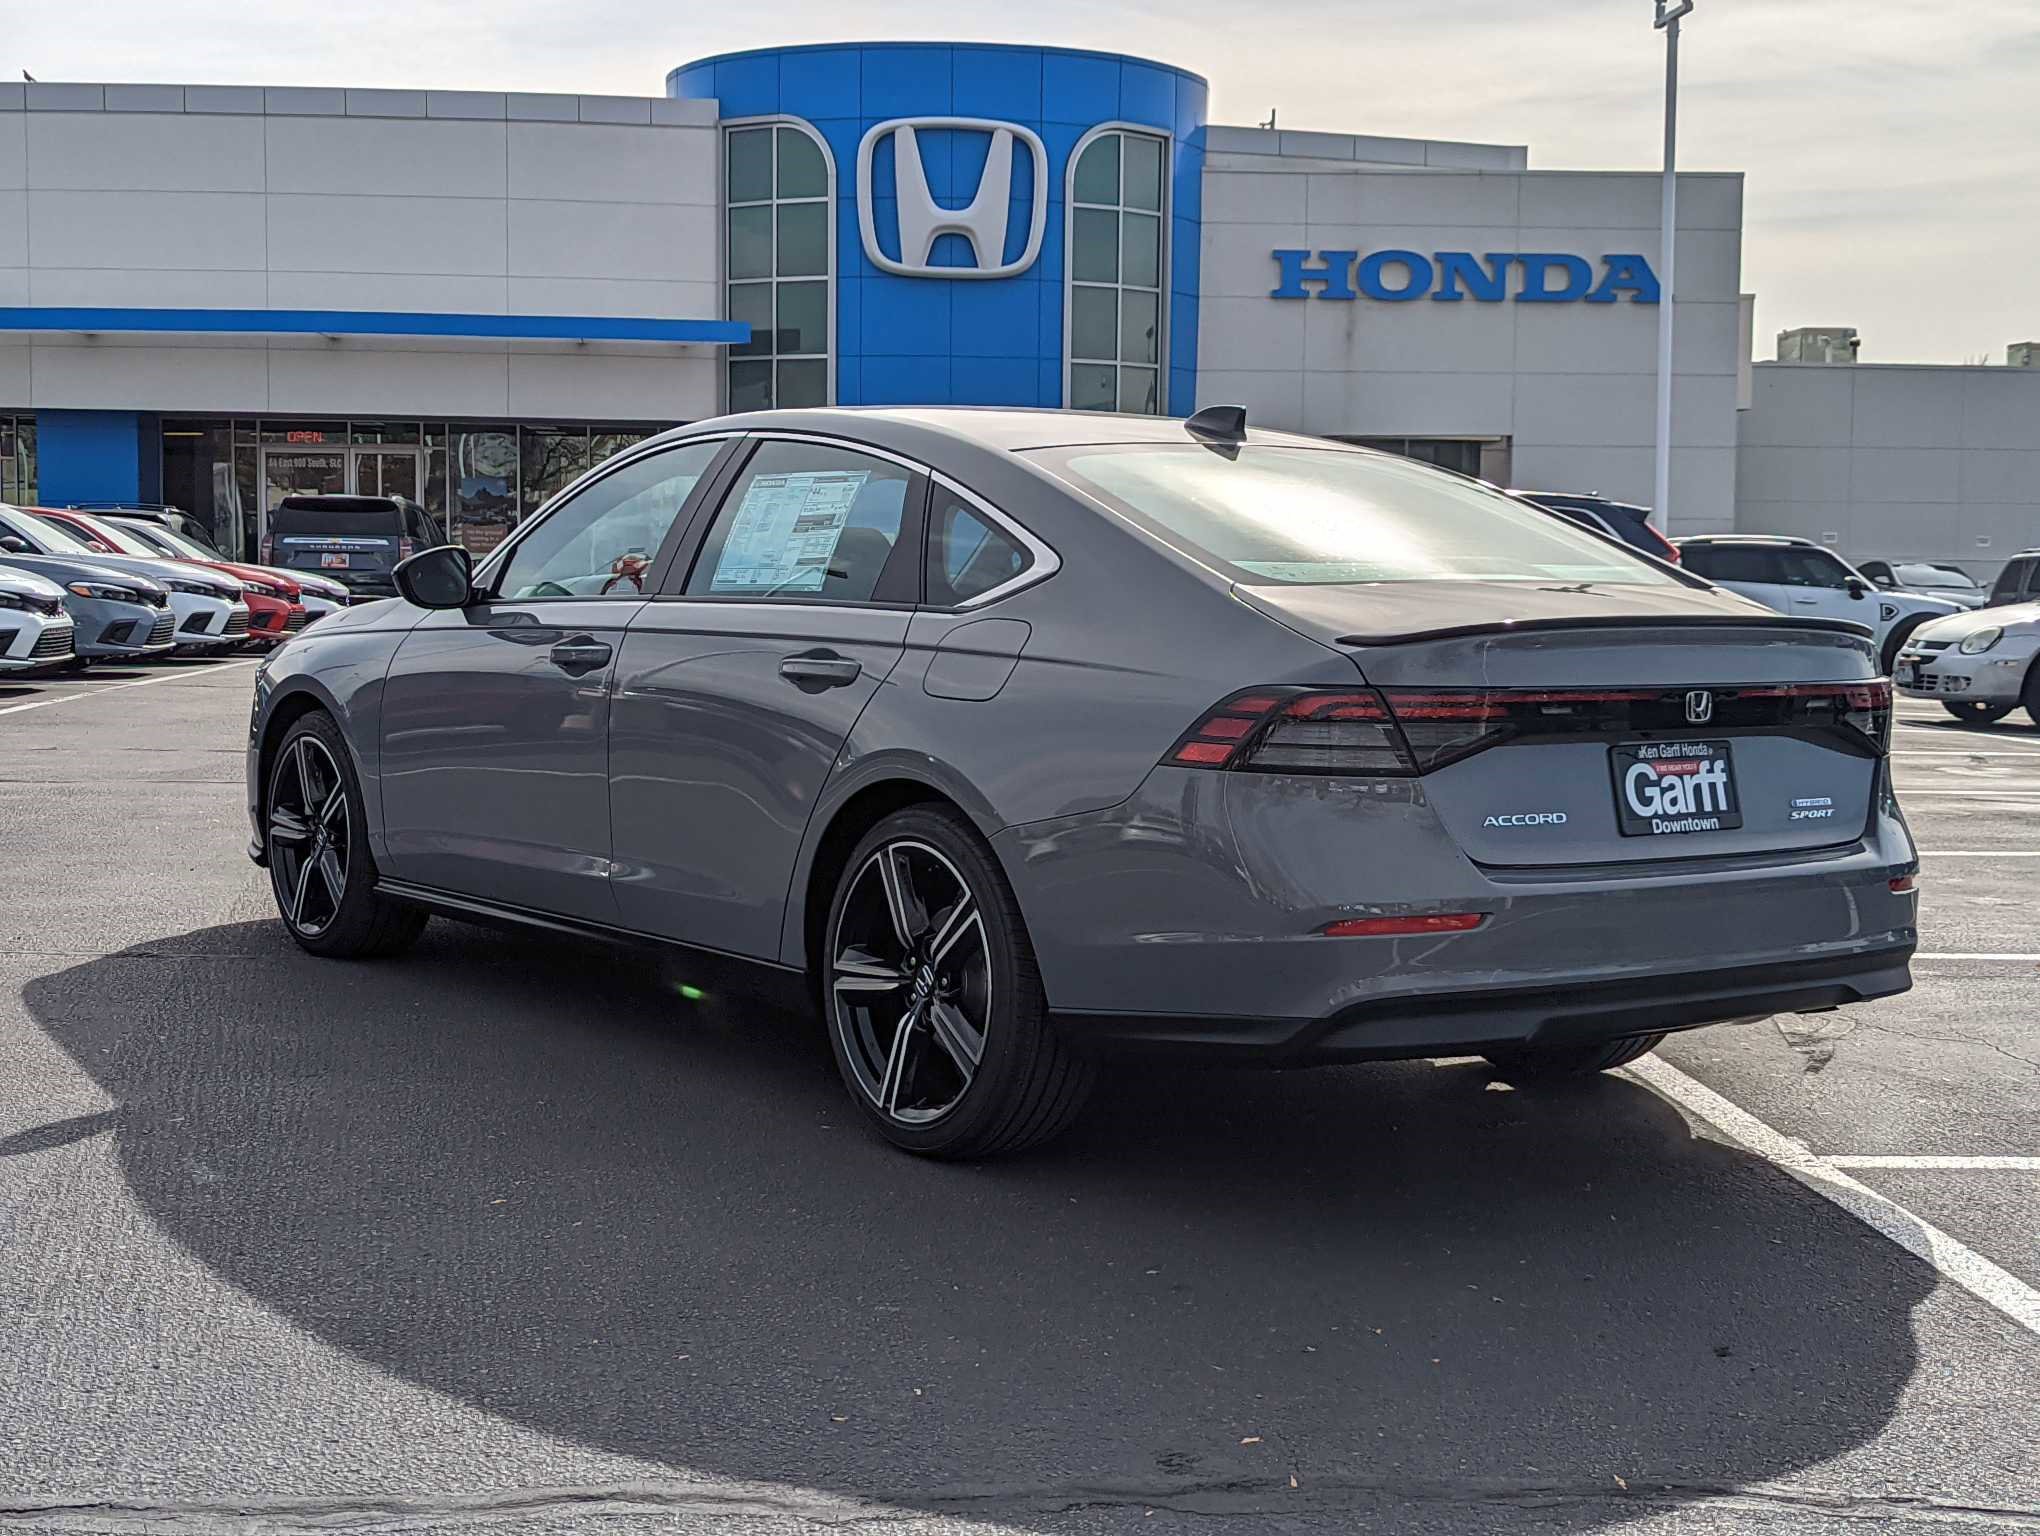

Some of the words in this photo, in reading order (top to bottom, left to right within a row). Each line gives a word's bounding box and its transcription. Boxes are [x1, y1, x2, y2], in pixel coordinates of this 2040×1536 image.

[1270, 249, 1660, 304] HONDA
[287, 431, 323, 443] OPEN
[1641, 745, 1659, 758] Ken
[1660, 744, 1680, 757] Garff
[1682, 743, 1708, 756] Honda
[1625, 760, 1728, 817] Garff
[1483, 813, 1567, 827] ACCORD
[1790, 809, 1836, 819] SPORT
[1652, 818, 1719, 834] Downtown
